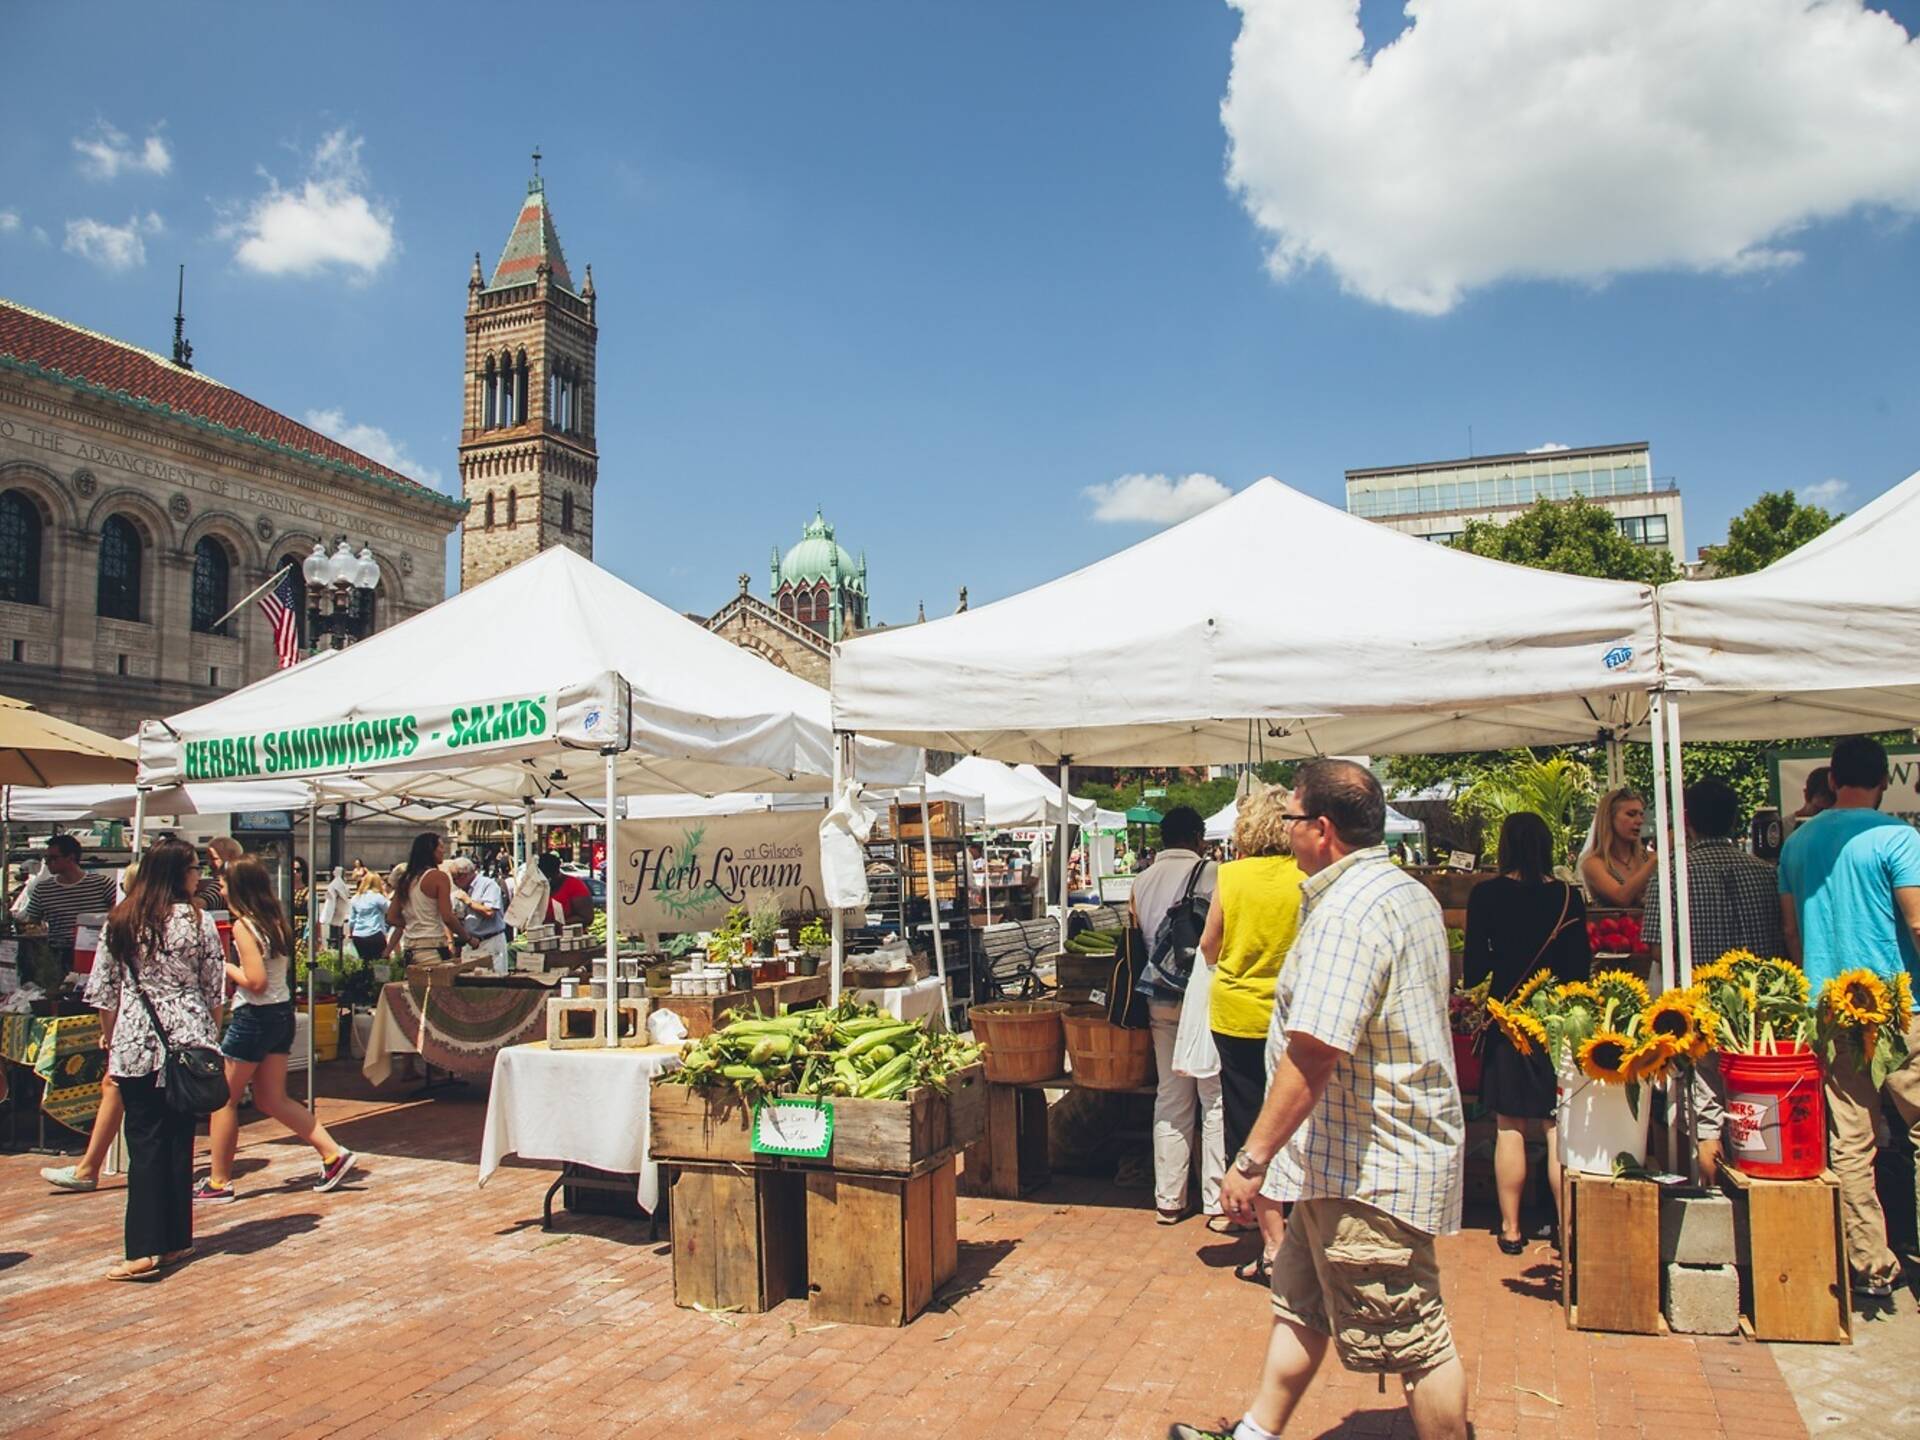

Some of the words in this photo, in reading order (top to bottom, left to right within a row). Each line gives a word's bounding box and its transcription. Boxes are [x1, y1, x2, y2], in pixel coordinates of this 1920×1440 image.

[27, 428, 64, 450] THE
[77, 443, 201, 489] ADVANCEMENT
[209, 479, 230, 496] OF
[240, 486, 310, 516] LEARNING
[185, 734, 261, 780] HERBAL
[263, 714, 420, 773] SANDWICHES
[446, 694, 547, 748] SALADS
[622, 845, 701, 905] Herb
[704, 847, 803, 904] Lyceum
[743, 848, 756, 859] at
[759, 842, 804, 859] Gilson's
[618, 880, 635, 893] The
